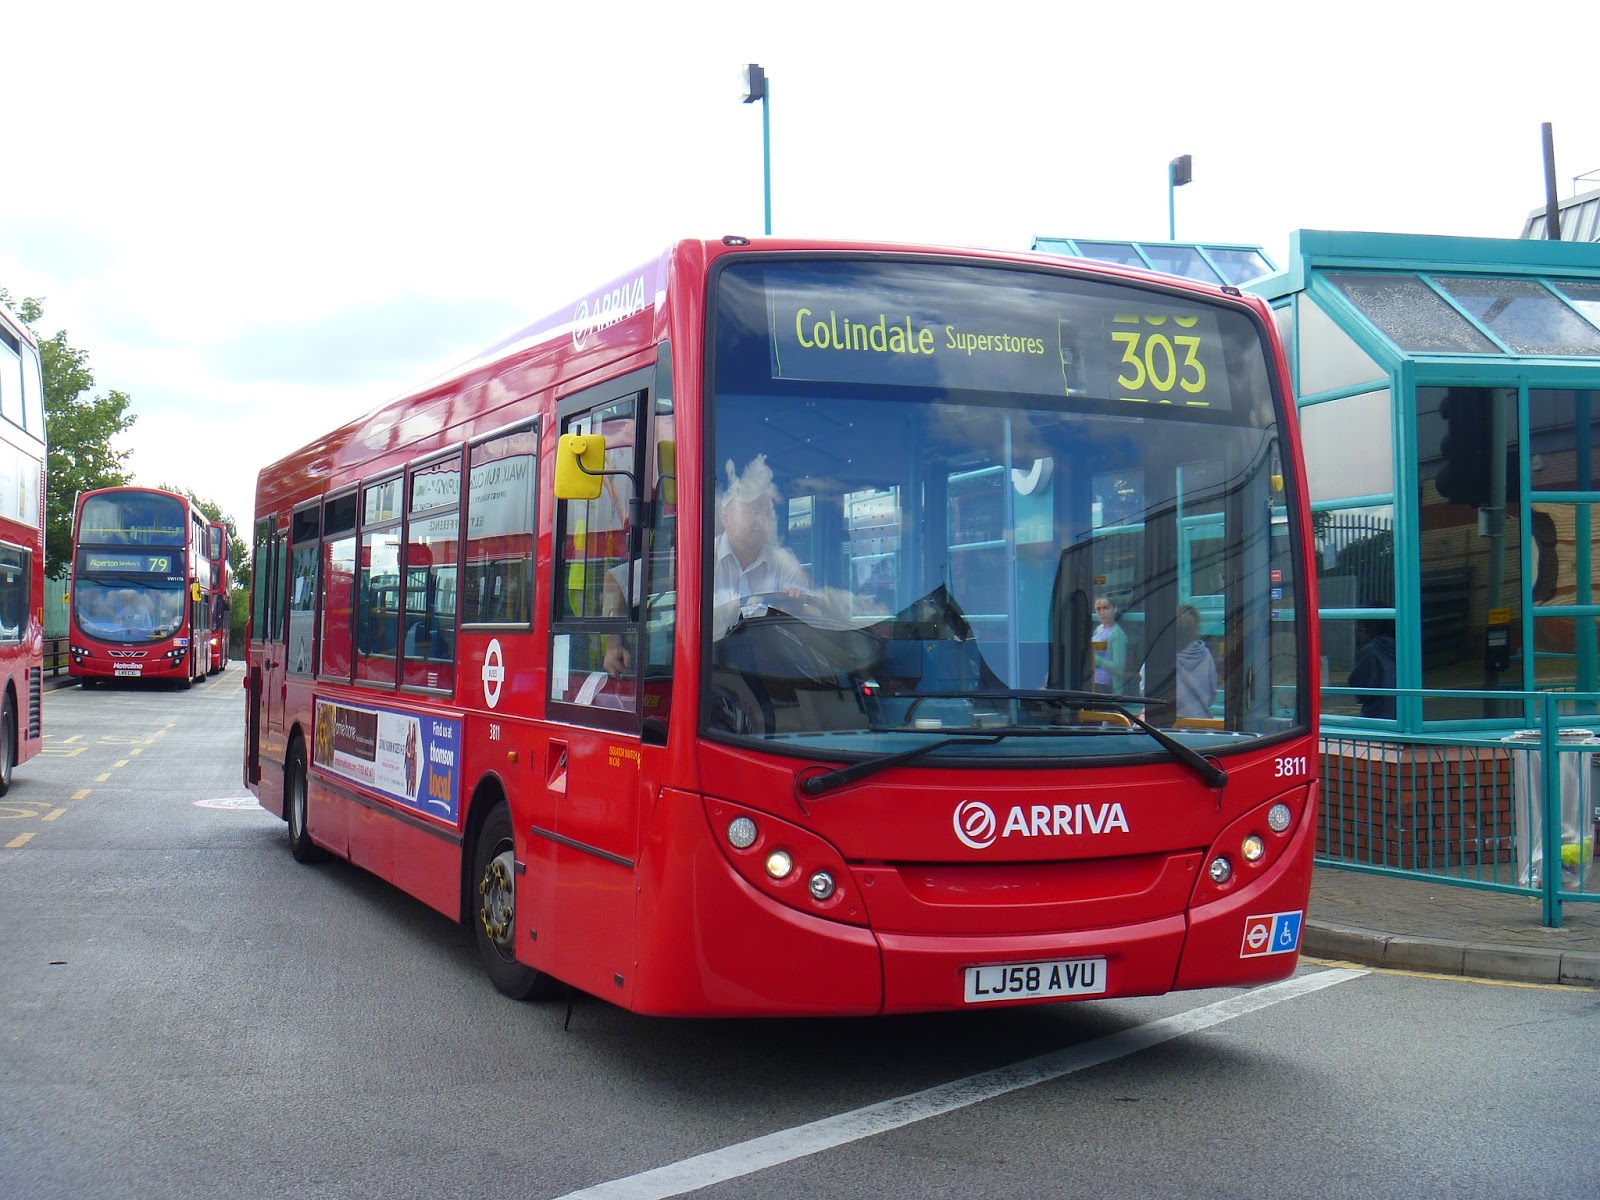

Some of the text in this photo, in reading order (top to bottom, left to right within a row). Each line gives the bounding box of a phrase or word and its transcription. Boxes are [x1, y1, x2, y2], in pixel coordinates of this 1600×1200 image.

[590, 275, 646, 333] ARRIVA
[795, 306, 1045, 356] Colindale Superstores
[1111, 332, 1206, 393] 303
[90, 558, 118, 568] Alperton
[149, 558, 168, 572] 79
[113, 662, 143, 670] Metroline
[432, 720, 443, 737] Find
[447, 726, 453, 739] at
[489, 723, 501, 741] 3811
[430, 740, 454, 767] thomson
[1274, 756, 1307, 779] 3811
[429, 764, 452, 801] local
[1002, 803, 1130, 838] ARRIVA
[975, 962, 1097, 996] LJ58 AVU
